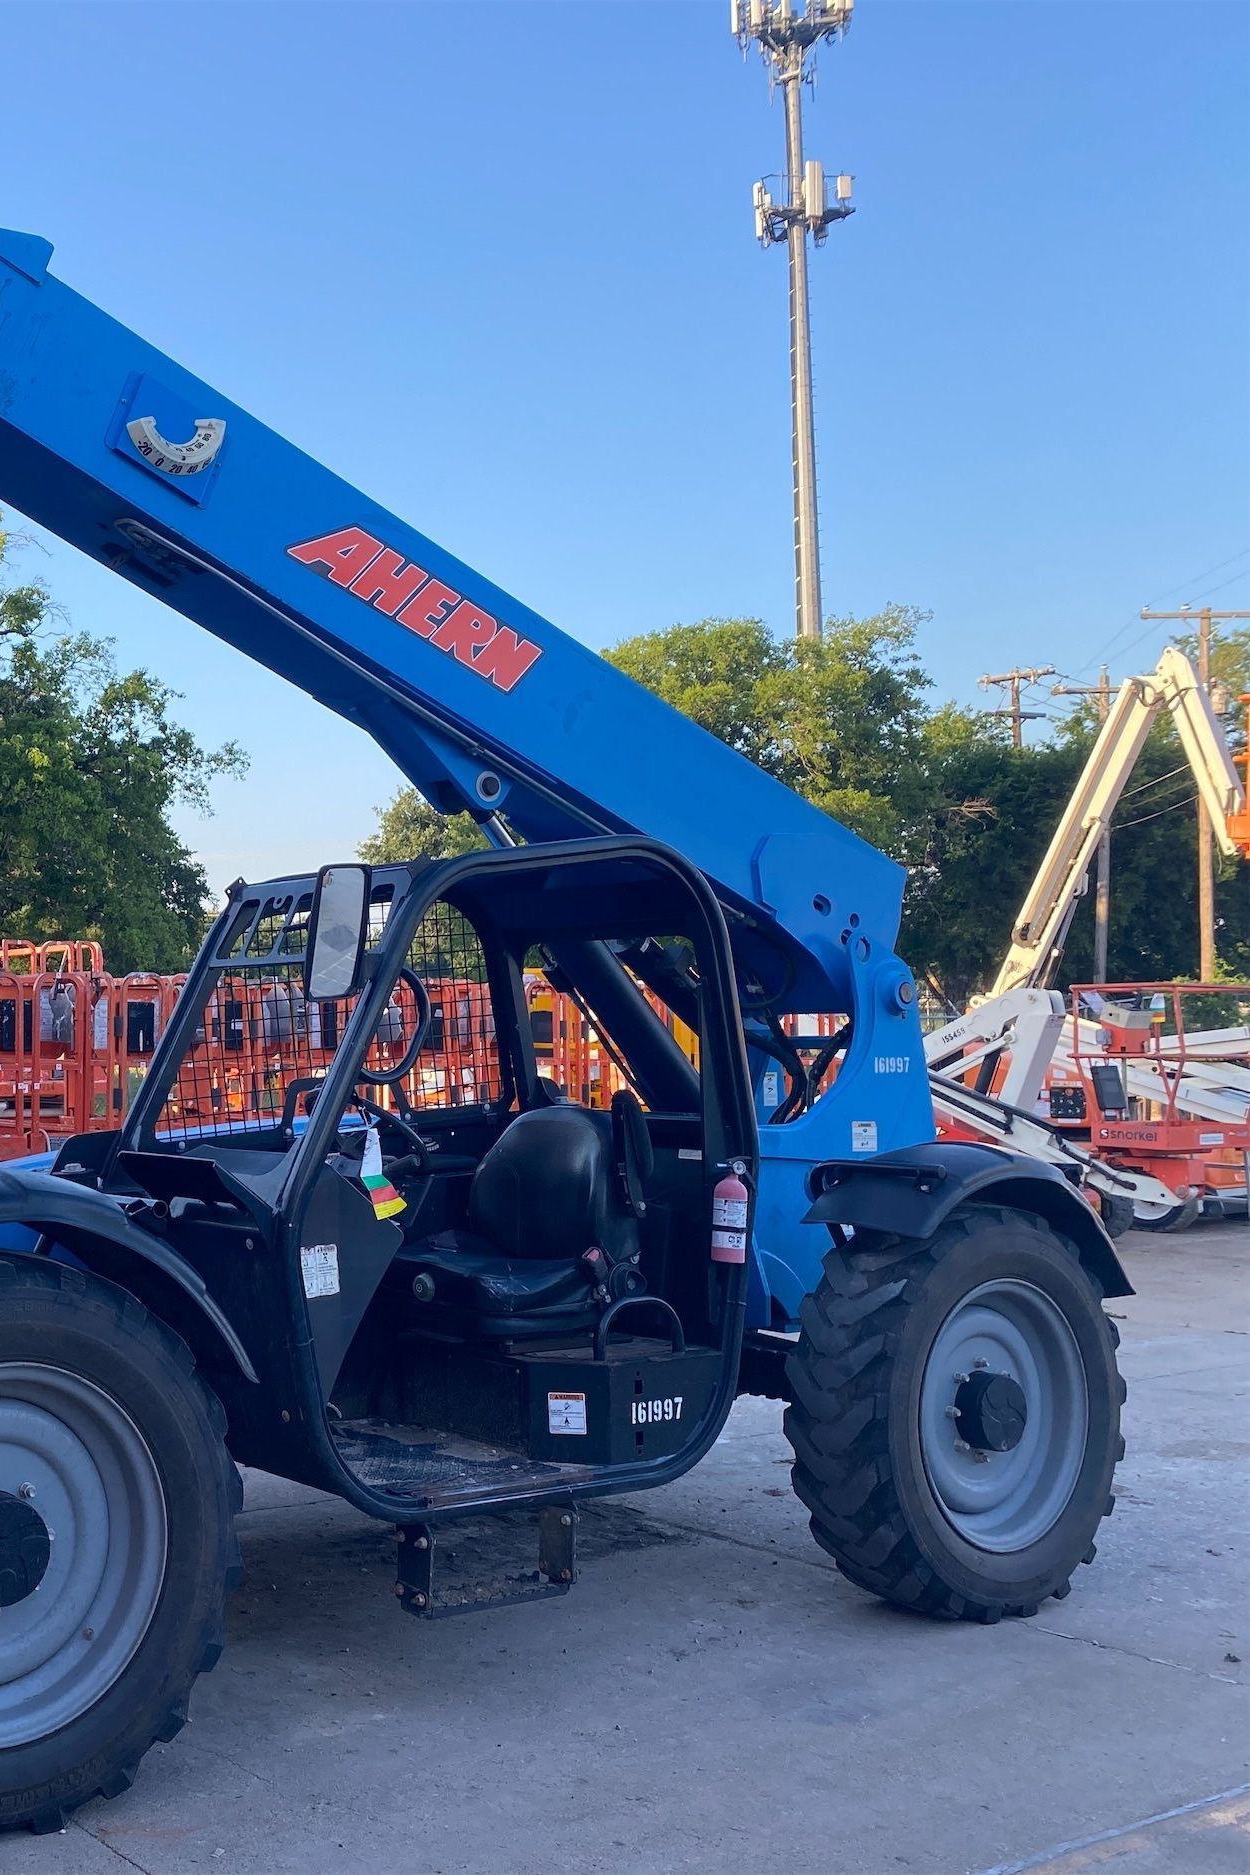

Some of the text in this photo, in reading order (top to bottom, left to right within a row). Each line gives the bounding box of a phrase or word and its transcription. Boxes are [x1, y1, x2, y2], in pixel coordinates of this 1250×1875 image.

[137, 440, 153, 456] -20
[154, 458, 165, 467] 0
[169, 464, 183, 474] 20
[186, 464, 199, 474] 40
[286, 525, 544, 693] AHERN
[874, 1056, 910, 1074] 161997
[1111, 1129, 1158, 1142] snorkel
[631, 1396, 683, 1425] 161997
